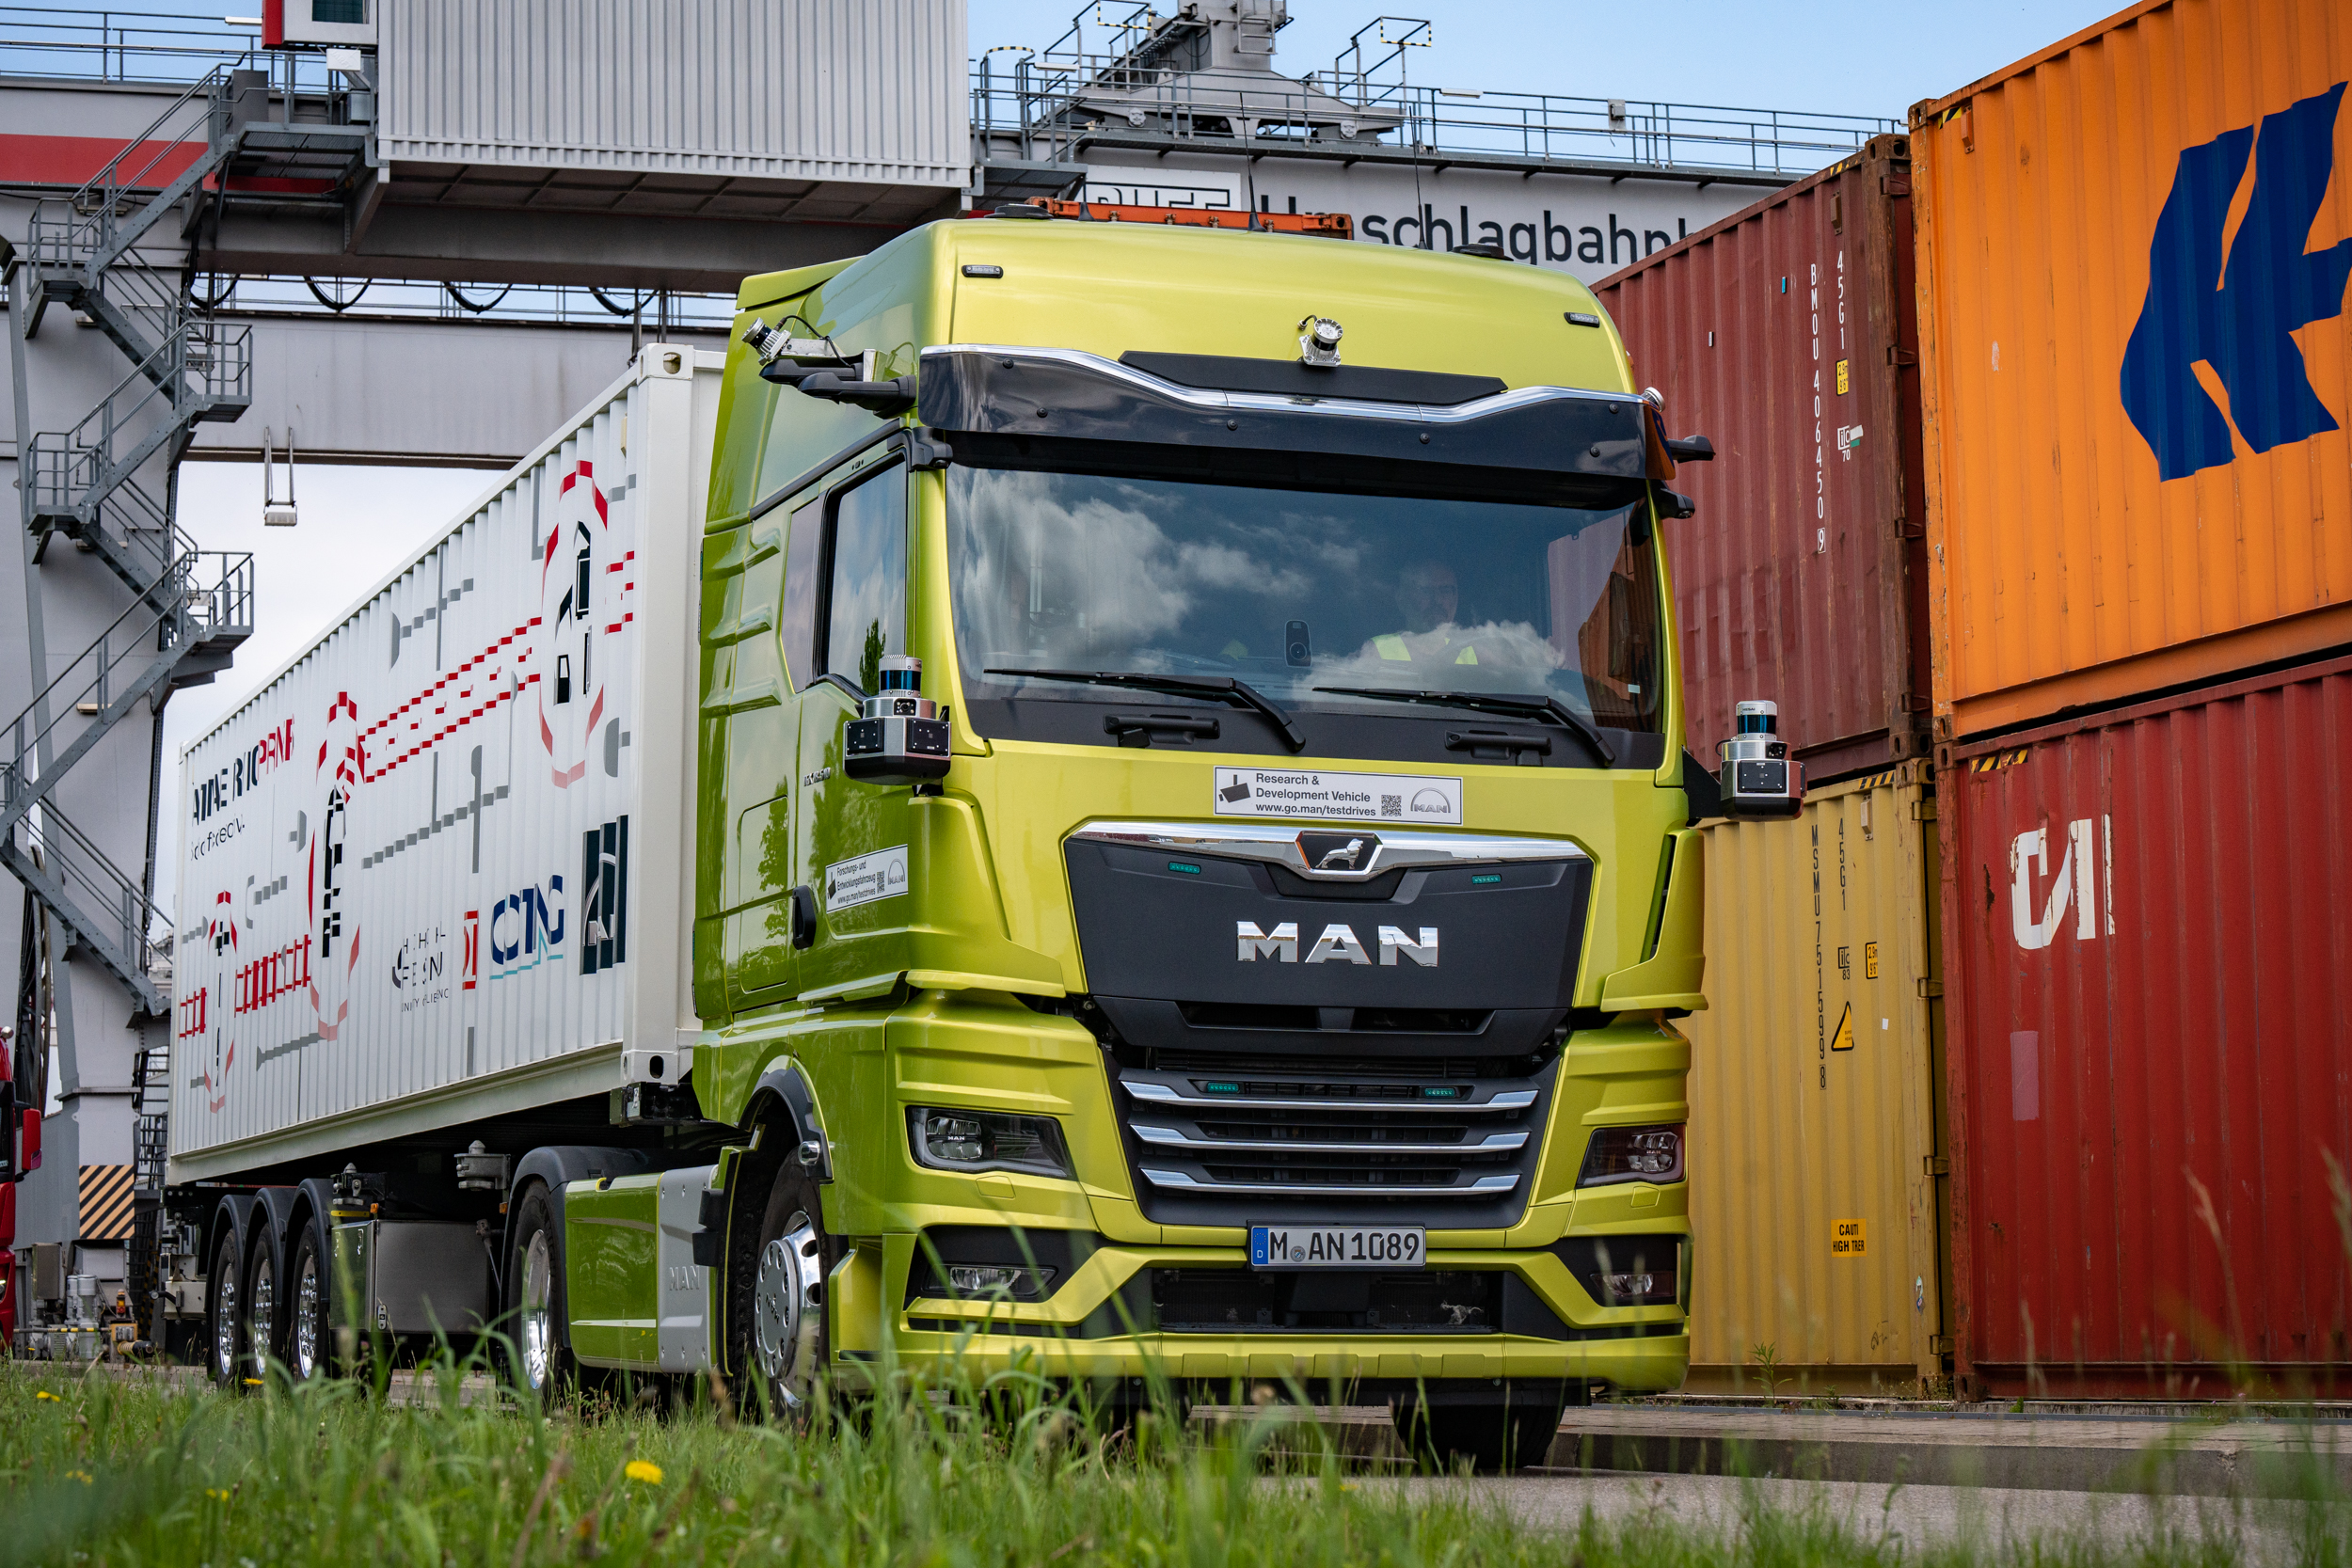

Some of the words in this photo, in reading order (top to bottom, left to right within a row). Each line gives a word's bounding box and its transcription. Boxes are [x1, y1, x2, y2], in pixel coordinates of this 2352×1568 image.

[1810, 263, 1820, 360] BMOU
[1813, 370, 1823, 519] 406450
[1842, 449, 1851, 462] 70
[1818, 528, 1825, 553] 9
[1256, 773, 1309, 785] Research
[1311, 775, 1320, 785] &
[1256, 788, 1329, 801] Development
[1331, 791, 1371, 802] Vehicle
[1255, 803, 1376, 816] www.go.man/testdrives
[1413, 803, 1448, 814] MAN
[1811, 824, 1820, 917] MSMU
[1237, 921, 1439, 967] MAN
[1842, 969, 1851, 980] 83
[1815, 921, 1825, 1060] 751599
[1256, 1249, 1263, 1259] D
[1270, 1231, 1288, 1260] M
[1308, 1232, 1344, 1260] AN
[1351, 1232, 1420, 1261] 1089
[669, 1265, 700, 1291] MAN
